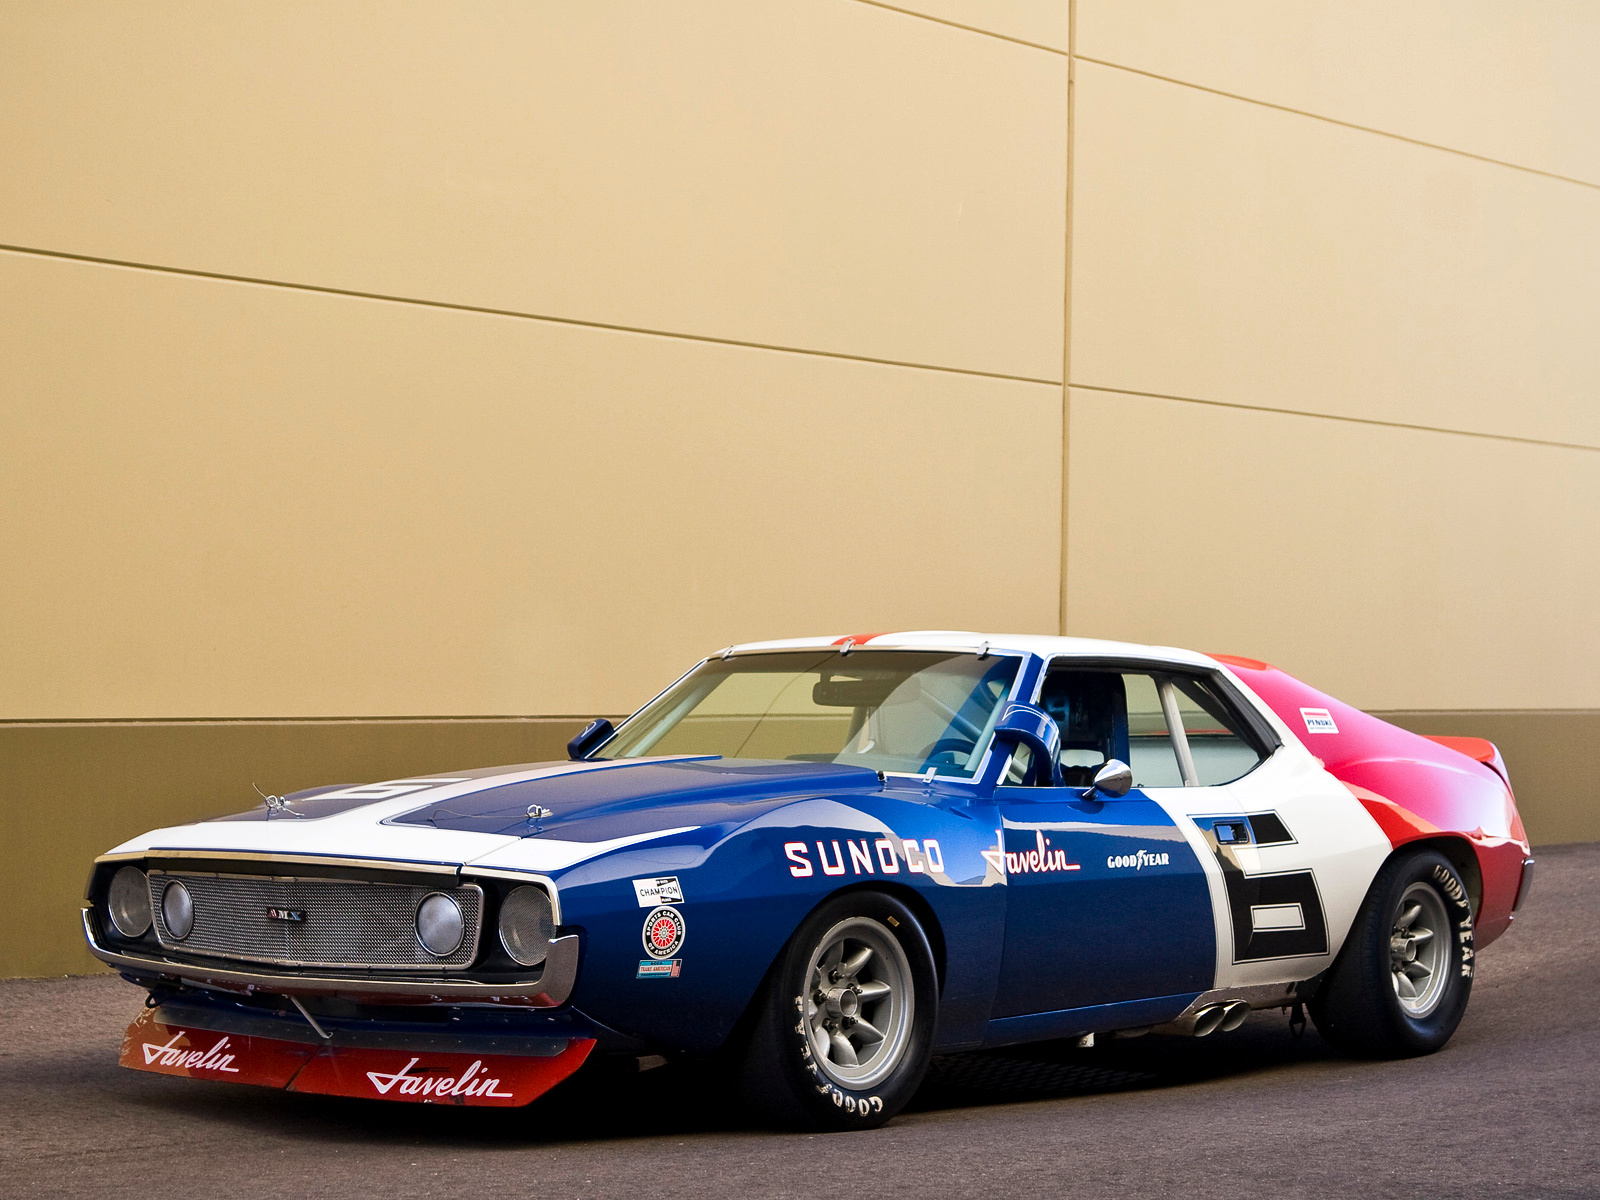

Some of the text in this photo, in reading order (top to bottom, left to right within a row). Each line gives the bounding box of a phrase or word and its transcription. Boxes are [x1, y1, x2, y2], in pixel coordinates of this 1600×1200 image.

[784, 838, 945, 878] SUNOCO
[980, 829, 1081, 875] Javelin
[1106, 849, 1170, 871] GOODYEAR
[639, 886, 679, 898] CHAMPION
[1186, 809, 1331, 966] 6
[267, 908, 302, 921] AMX
[646, 911, 682, 936] SPORTS CAR CLUB
[648, 941, 679, 956] OF AMERICA
[142, 1030, 240, 1073] Javelin
[366, 1057, 513, 1098] Javelin
